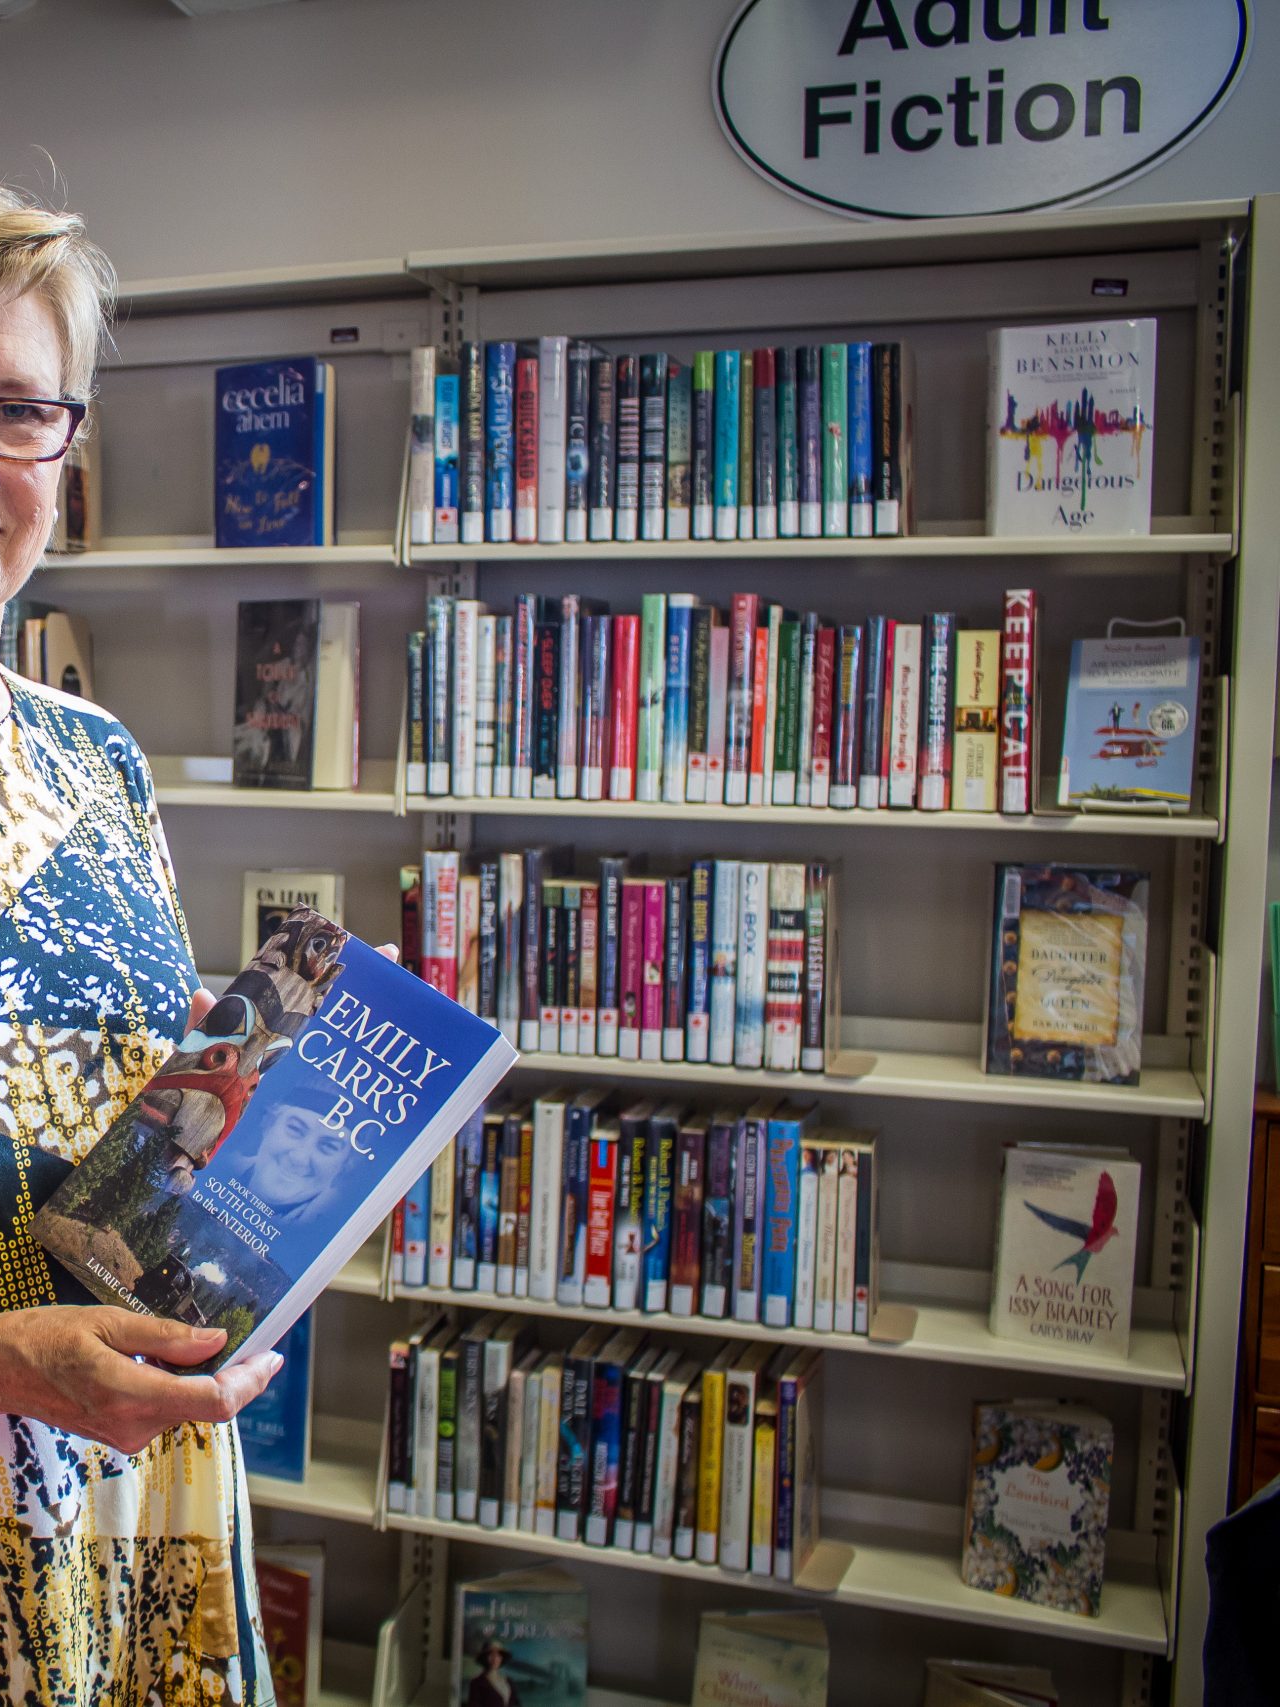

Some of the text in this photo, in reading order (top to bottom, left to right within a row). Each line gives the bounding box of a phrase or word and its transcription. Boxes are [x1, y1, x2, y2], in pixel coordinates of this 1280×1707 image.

[803, 68, 1142, 159] Fiction
[1046, 329, 1110, 346] KELLY
[1016, 351, 1141, 375] BENSIMON
[221, 372, 306, 413] cecelia
[235, 409, 291, 434] ahern
[519, 390, 536, 480] QUICKSAND
[570, 414, 585, 448] ICE
[490, 423, 513, 468] PETAL
[1016, 470, 1135, 498] Dangerous
[1051, 504, 1095, 533] Age
[670, 634, 681, 672] BERG
[1004, 588, 1032, 781] KEEP CAL
[257, 888, 319, 906] ON LEAVE
[437, 867, 456, 949] TOM CLANCY
[481, 872, 496, 937] Lisa Black
[583, 918, 596, 948] GILES
[607, 906, 617, 937] BLUNT
[744, 911, 758, 956] BOX
[778, 913, 796, 929] THE
[1031, 949, 1108, 965] DAUGHTER
[1040, 995, 1090, 1010] QUEEN
[319, 990, 452, 1089] EMILY
[297, 1029, 418, 1125] CARR'S
[318, 1094, 387, 1161] B.C.
[659, 1138, 673, 1176] Robert
[770, 1137, 795, 1213] PALISADES
[743, 1136, 758, 1220] ALLISON BRENNAN
[204, 1176, 281, 1241] SOUTH COAST
[227, 1177, 275, 1219] BOOK THREE
[192, 1189, 270, 1258] to the INTERIOR
[86, 1256, 121, 1291] LAURIE
[1016, 1273, 1114, 1309] A SONG FOR
[1008, 1296, 1119, 1331] ISSY BRADLEY
[1030, 1323, 1095, 1345] CARYS BRAY
[1026, 1472, 1051, 1489] The
